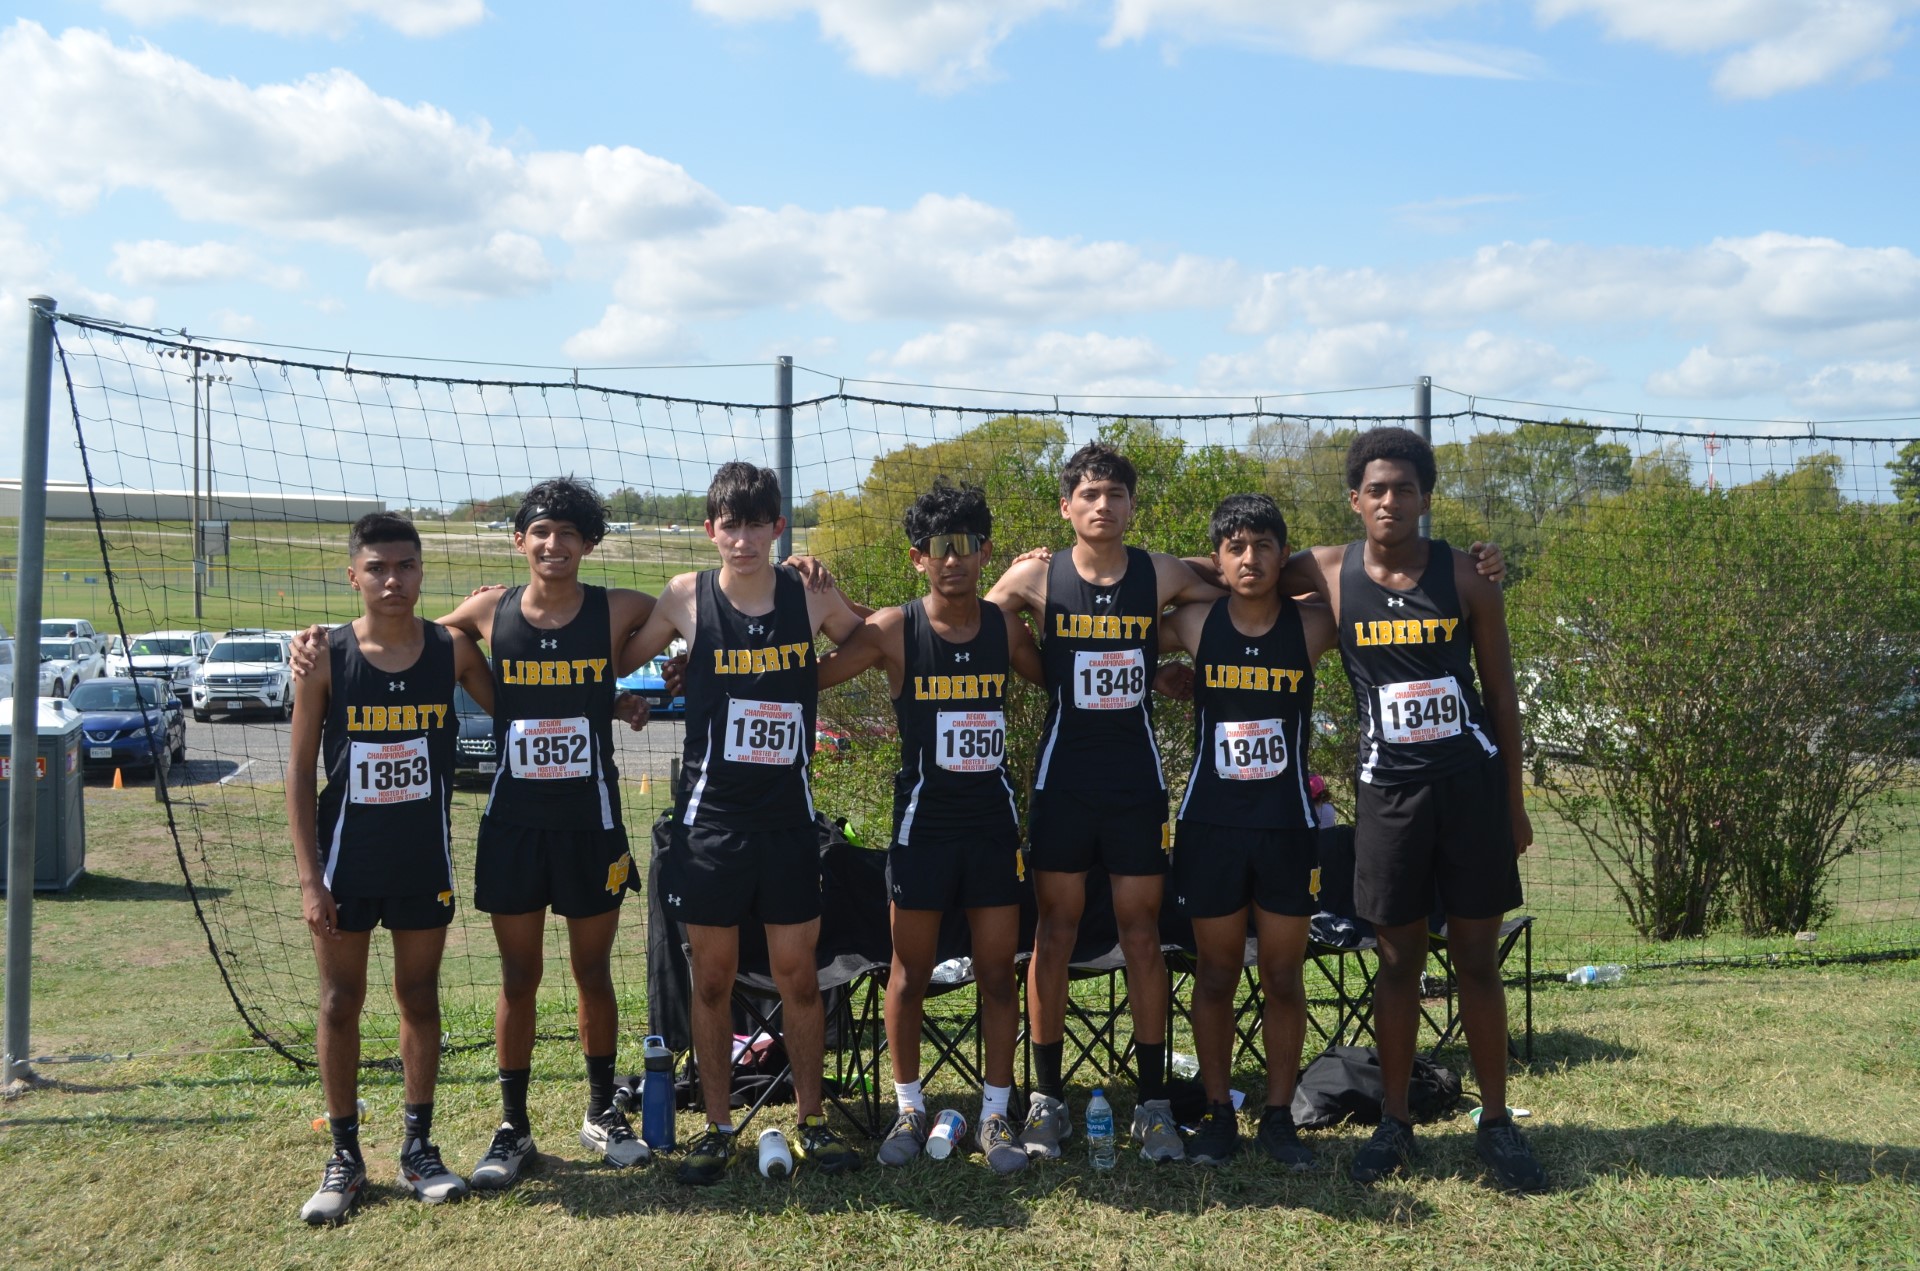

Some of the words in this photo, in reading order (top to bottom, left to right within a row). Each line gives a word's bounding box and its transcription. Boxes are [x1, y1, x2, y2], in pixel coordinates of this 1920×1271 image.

[1056, 613, 1152, 639] LIBERTY
[1354, 618, 1459, 647] LIBERTY
[502, 658, 607, 685] LIBERTY
[714, 642, 809, 674] LIBERTY
[914, 674, 1005, 700] LIBERTY
[1080, 665, 1144, 696] 1348
[1205, 664, 1304, 692] LIBERTY
[1408, 682, 1431, 690] REGION
[1395, 687, 1446, 699] CHAMPIONSHIPS
[347, 704, 447, 731] LIBERTY
[744, 708, 793, 719] CHAMPIONSHIPS
[760, 703, 782, 711] REGION
[1387, 694, 1458, 730] 1349
[524, 726, 576, 736] CHAMPIONSHIPS
[538, 720, 561, 728] REGION
[733, 718, 796, 750] 1351
[366, 749, 418, 760] CHAMPIONSHIPS
[382, 744, 405, 752] REGION
[515, 734, 588, 766] 1352
[943, 728, 1004, 758] 1350
[1219, 735, 1285, 767] 1346
[357, 756, 428, 790] 1353
